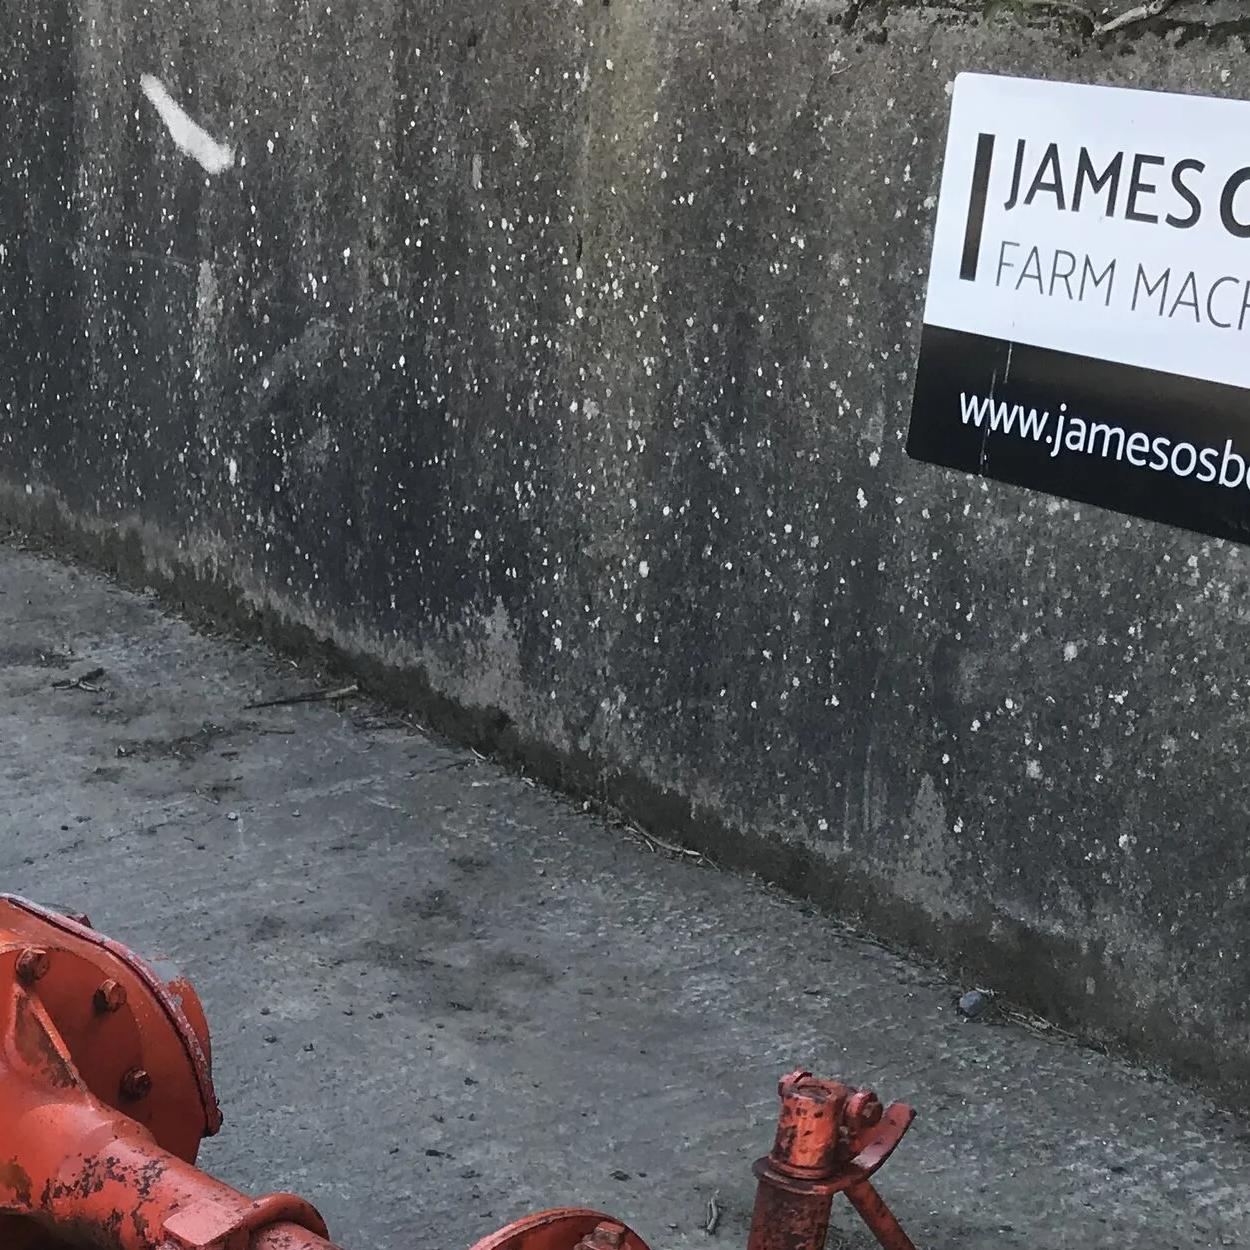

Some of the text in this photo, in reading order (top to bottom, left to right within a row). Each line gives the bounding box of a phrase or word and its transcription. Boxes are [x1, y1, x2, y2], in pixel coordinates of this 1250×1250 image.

[1004, 139, 1206, 229] JAMES
[996, 240, 1117, 307] FARM
[960, 392, 1250, 490] www.jamesosb
